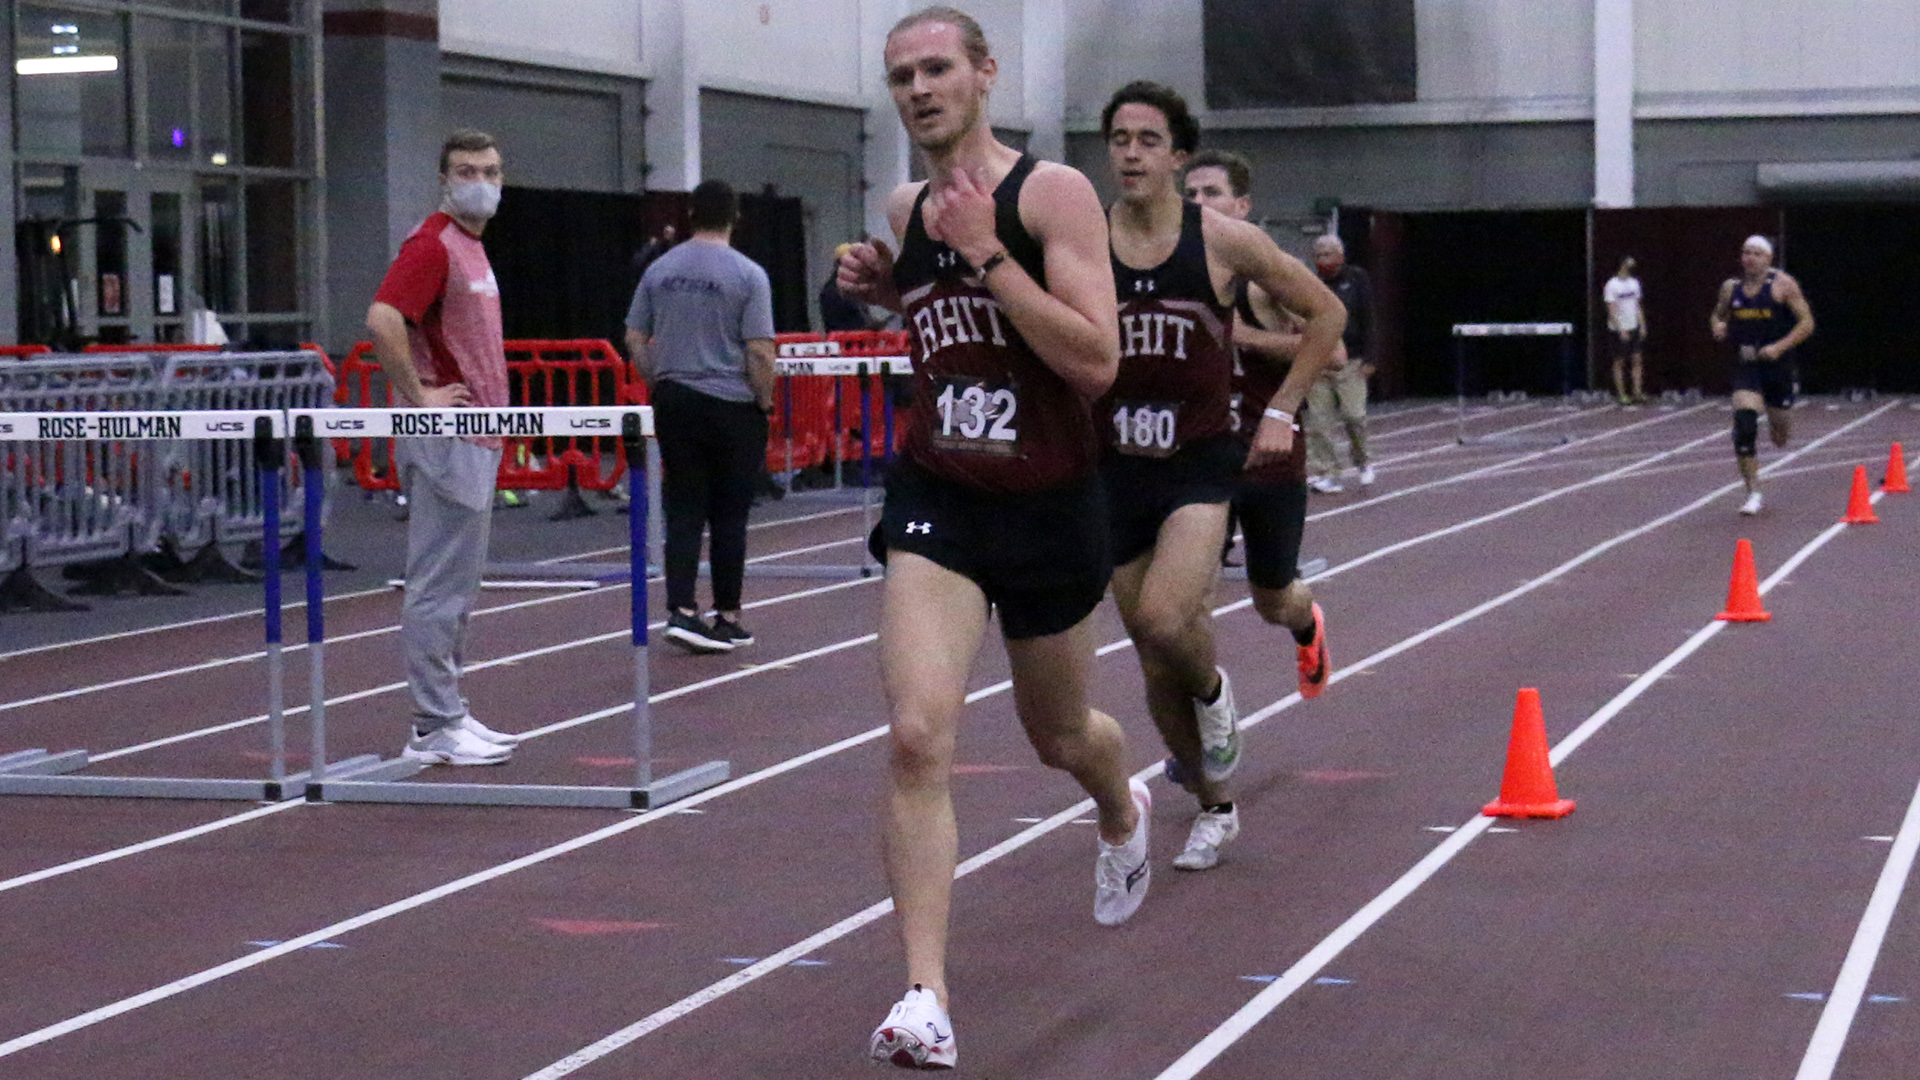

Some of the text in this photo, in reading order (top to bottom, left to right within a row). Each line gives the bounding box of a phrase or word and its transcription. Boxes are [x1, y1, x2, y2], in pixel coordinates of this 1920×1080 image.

[913, 296, 1007, 361] RHIT
[1122, 313, 1194, 360] HIT
[38, 416, 244, 438] ROSE-HULMAN UCS
[325, 413, 611, 436] UCS ROSE-HULMAN UCS
[936, 384, 1017, 440] 132
[1113, 405, 1175, 448] 180
